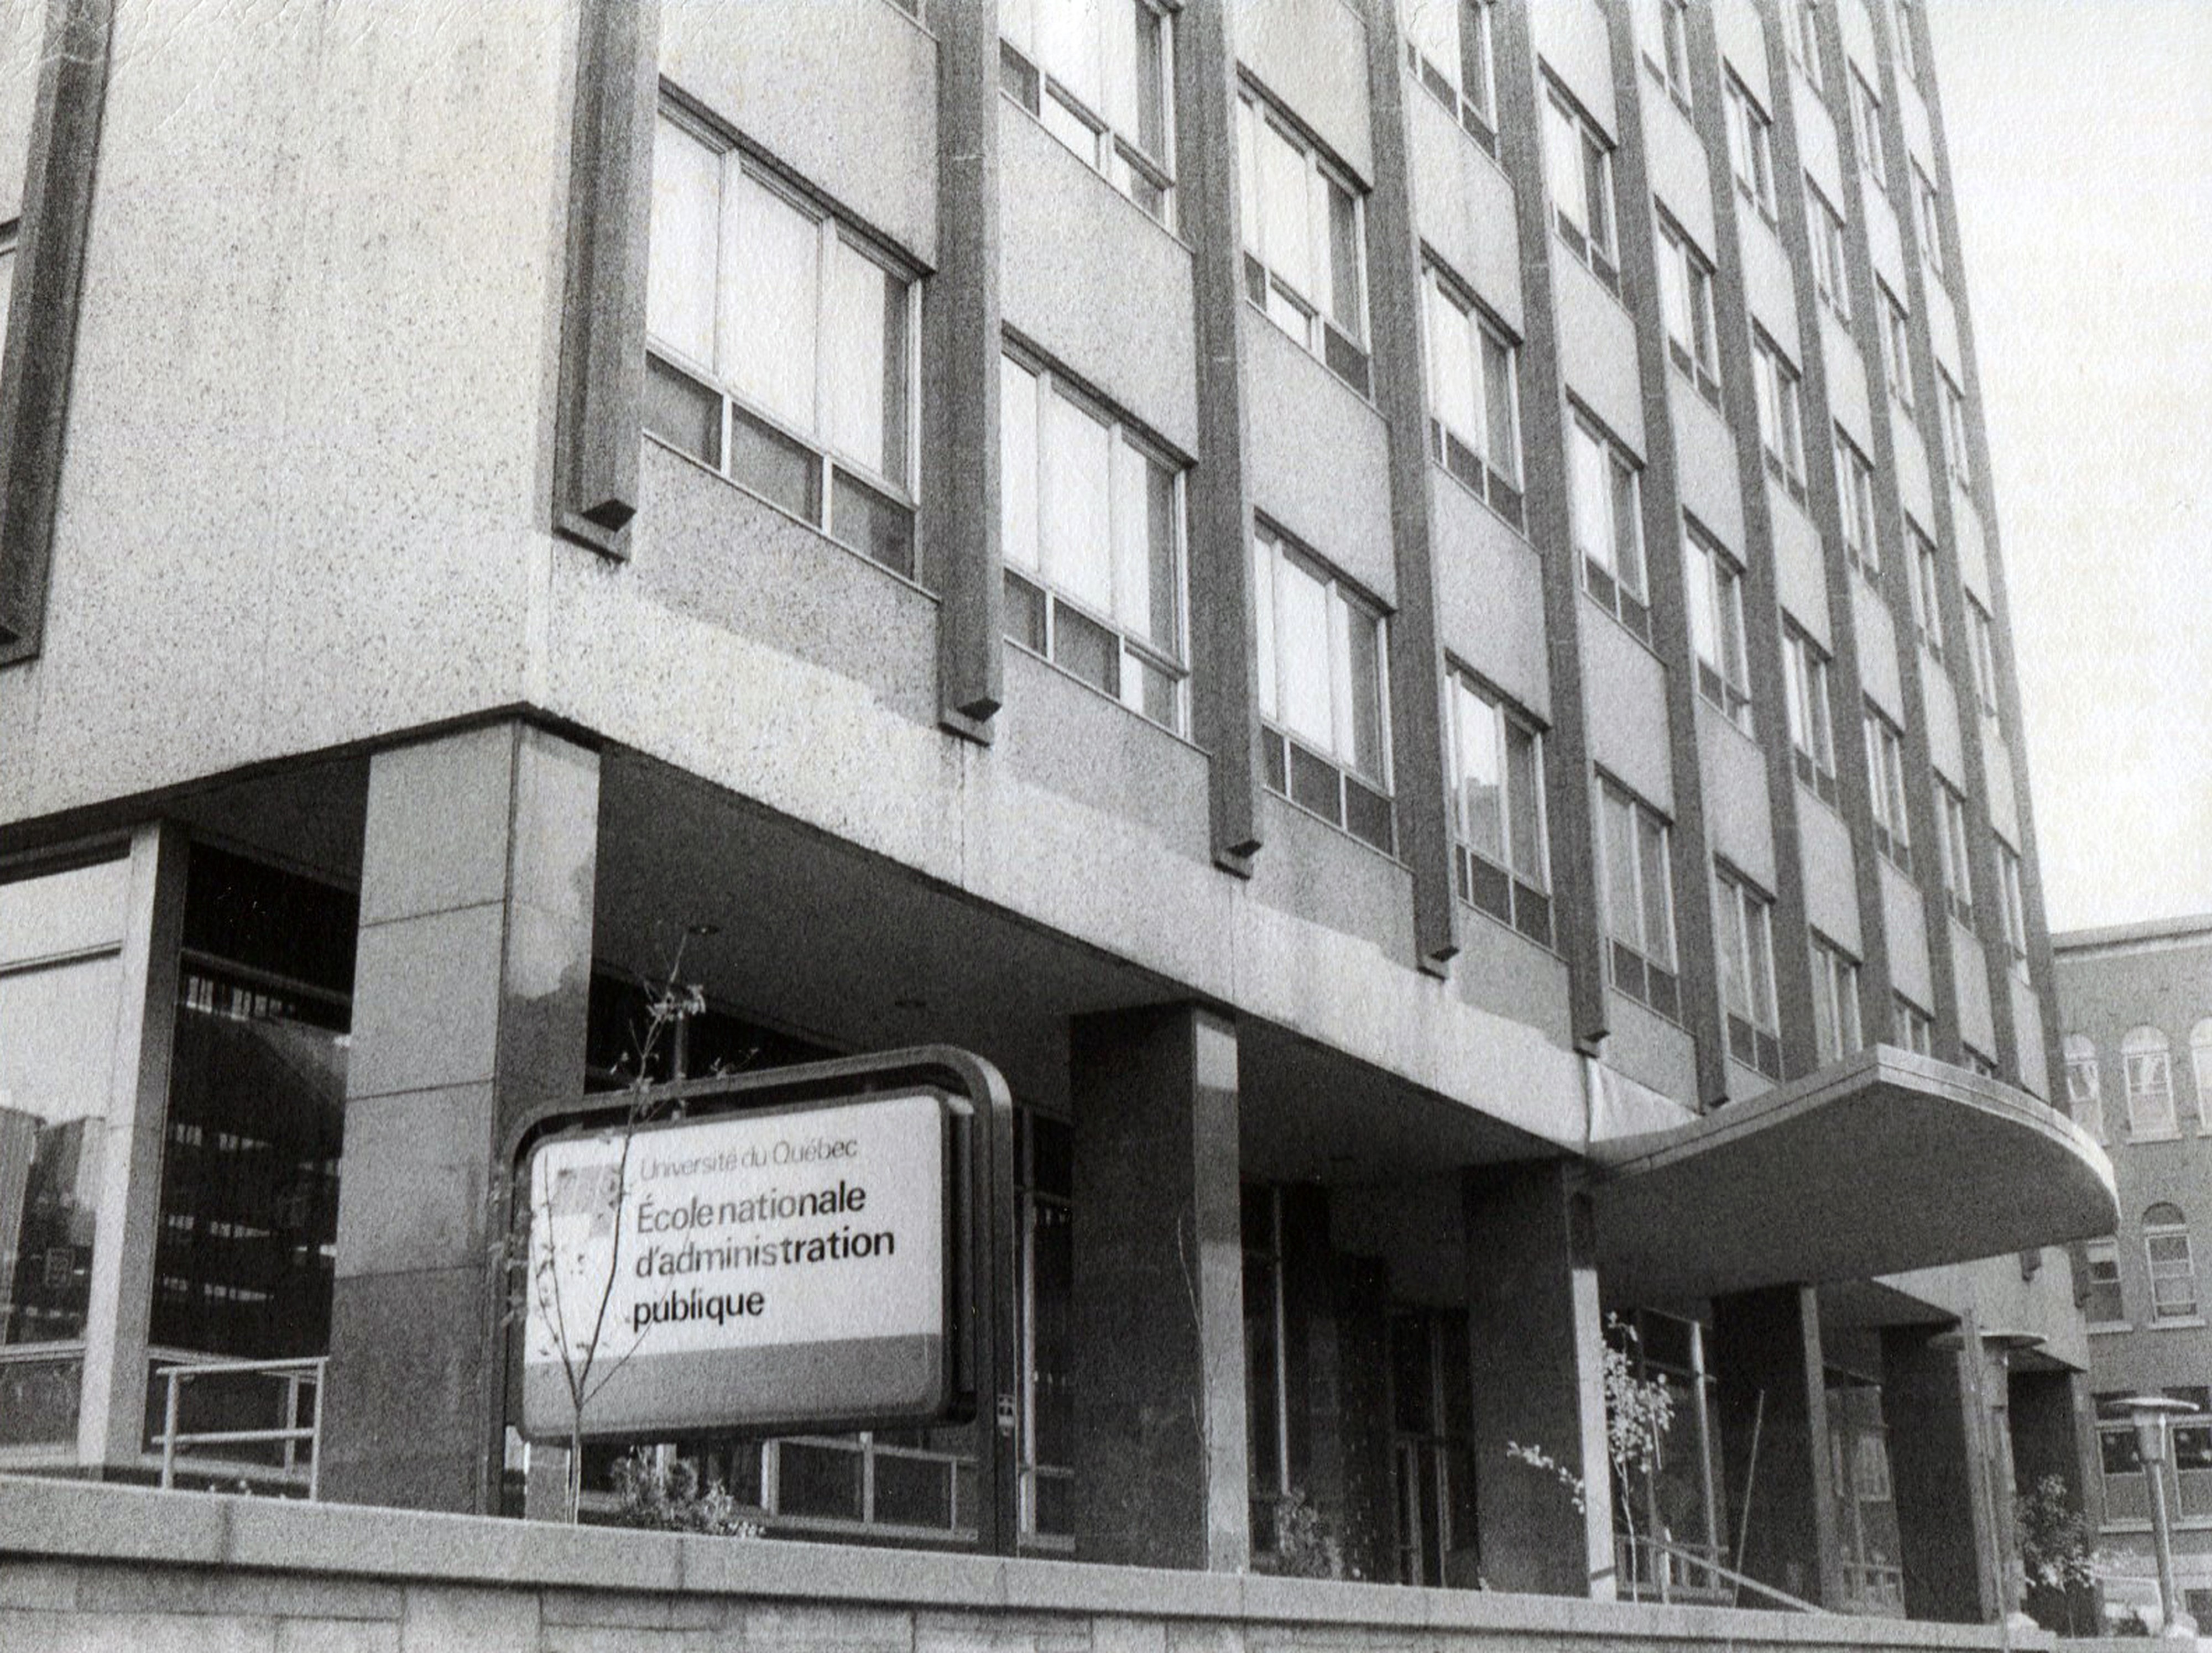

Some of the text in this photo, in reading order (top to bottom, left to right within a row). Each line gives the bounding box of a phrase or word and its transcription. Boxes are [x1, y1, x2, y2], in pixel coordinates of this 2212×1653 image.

[741, 1145, 767, 1169] du
[774, 1137, 858, 1164] Québec
[637, 1180, 867, 1234] École nationale
[635, 1225, 895, 1278] d'administration
[633, 1288, 765, 1333] publique
